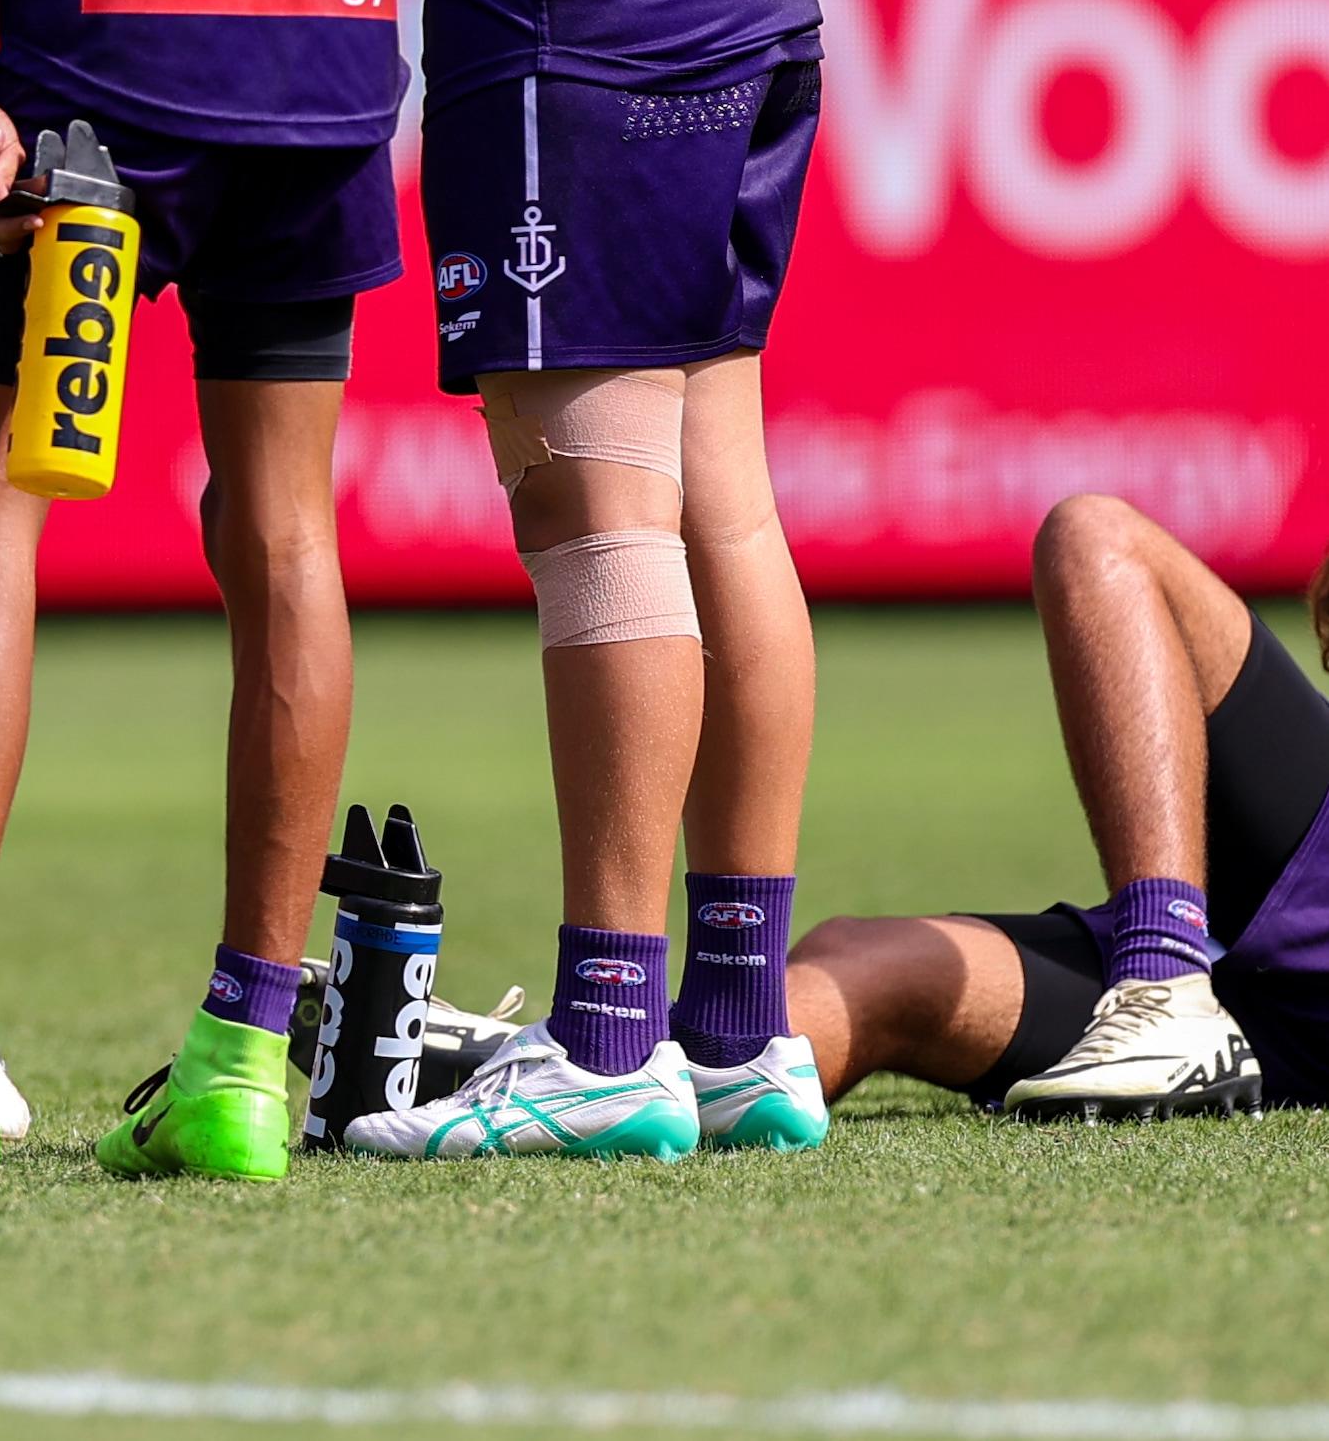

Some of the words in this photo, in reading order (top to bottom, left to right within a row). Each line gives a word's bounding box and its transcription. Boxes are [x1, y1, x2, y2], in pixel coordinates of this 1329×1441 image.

[438, 262, 481, 292] AFL
[44, 222, 126, 456] rebel
[581, 965, 639, 982] AFL
